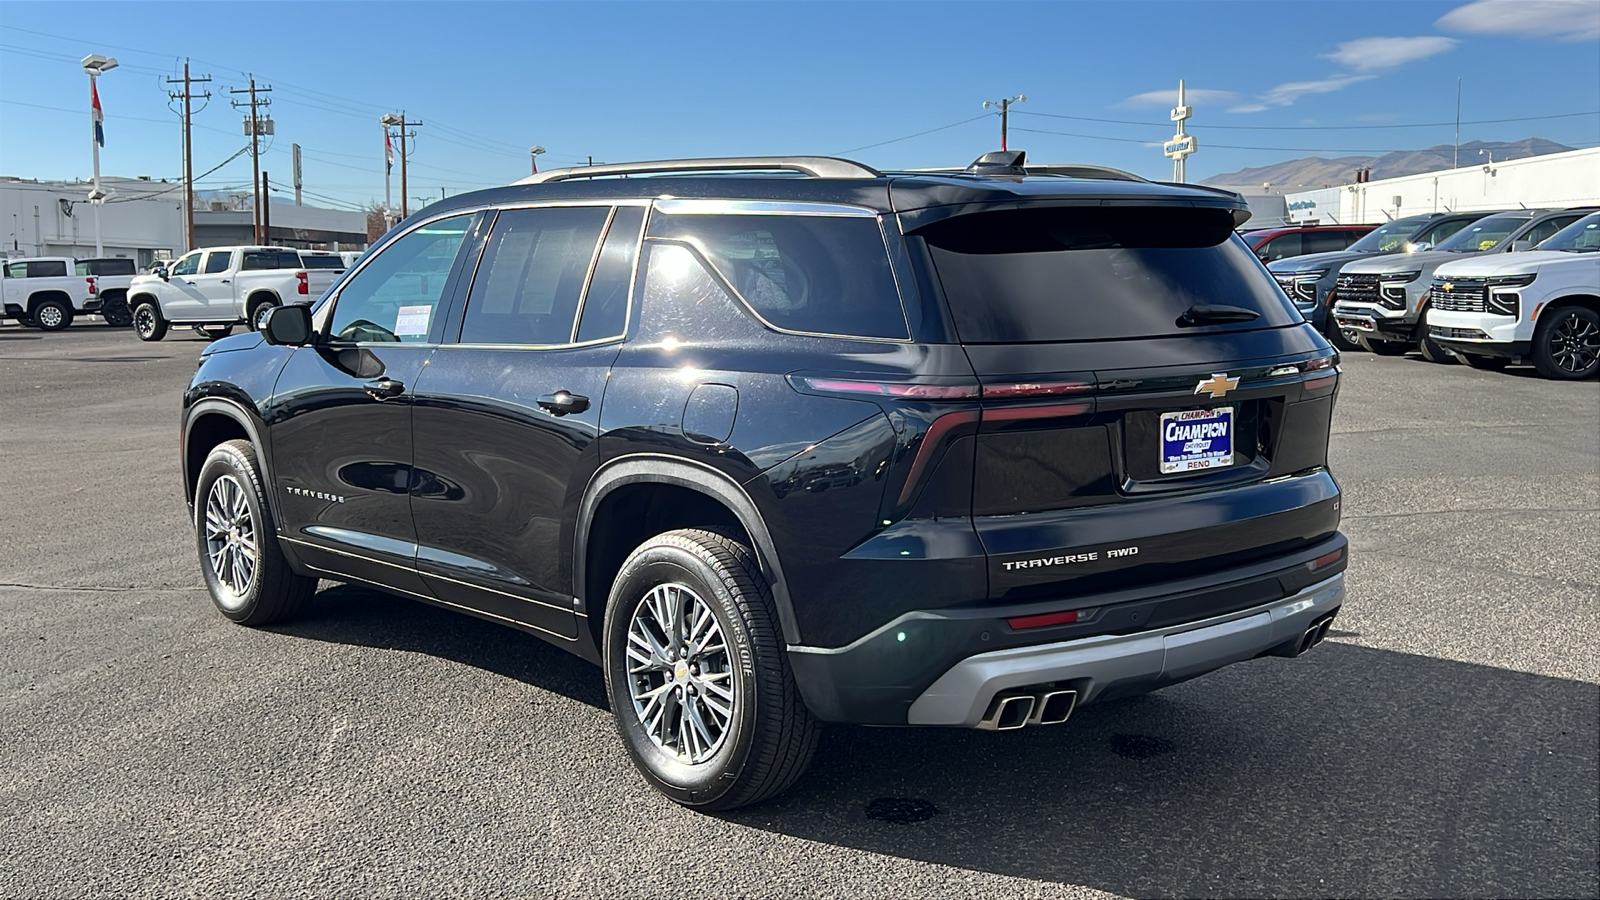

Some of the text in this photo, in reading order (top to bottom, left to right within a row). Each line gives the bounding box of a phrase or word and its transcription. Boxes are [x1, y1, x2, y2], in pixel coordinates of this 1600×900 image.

[1182, 410, 1215, 420] CHAMPION
[1185, 442, 1210, 450] CHEVROLET
[1187, 460, 1210, 469] RENO
[286, 486, 345, 504] TRAVERSE
[1002, 546, 1139, 571] TRAVERSE AWD
[716, 588, 754, 677] BRIDGESTONE
